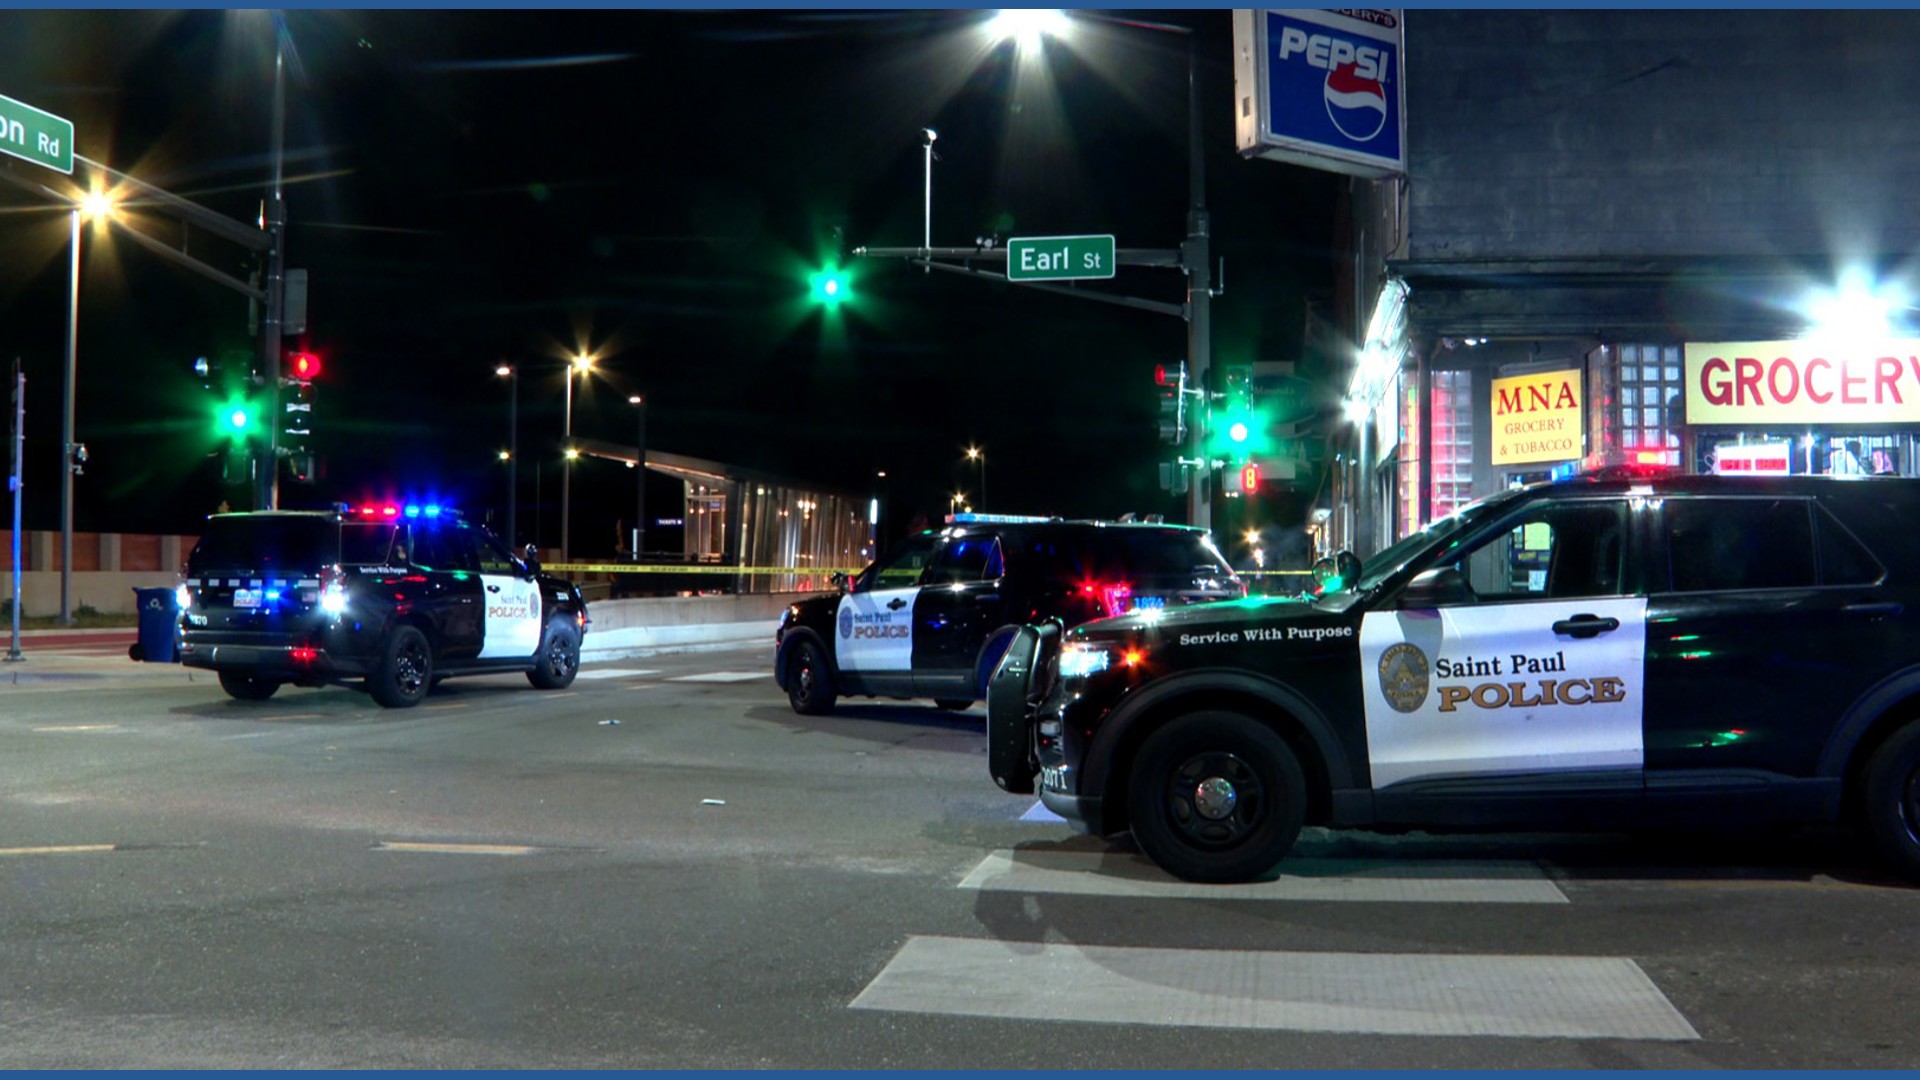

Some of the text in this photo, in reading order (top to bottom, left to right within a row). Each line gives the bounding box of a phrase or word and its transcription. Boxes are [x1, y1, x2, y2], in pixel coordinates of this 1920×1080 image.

[1279, 26, 1389, 83] PEPSI
[38, 131, 59, 157] Rd
[1021, 246, 1101, 271] Earl St
[1497, 381, 1578, 415] MNA
[1504, 418, 1564, 434] GROCERY
[1500, 438, 1572, 455] & TOBACCO
[488, 606, 527, 618] POLICE
[854, 612, 891, 623] Saint Paul
[854, 625, 909, 639] POLICE
[1180, 626, 1352, 645] Service With Purpose
[1436, 655, 1503, 679] Saint
[1510, 650, 1566, 675] Paul
[1436, 676, 1627, 713] POLICE
